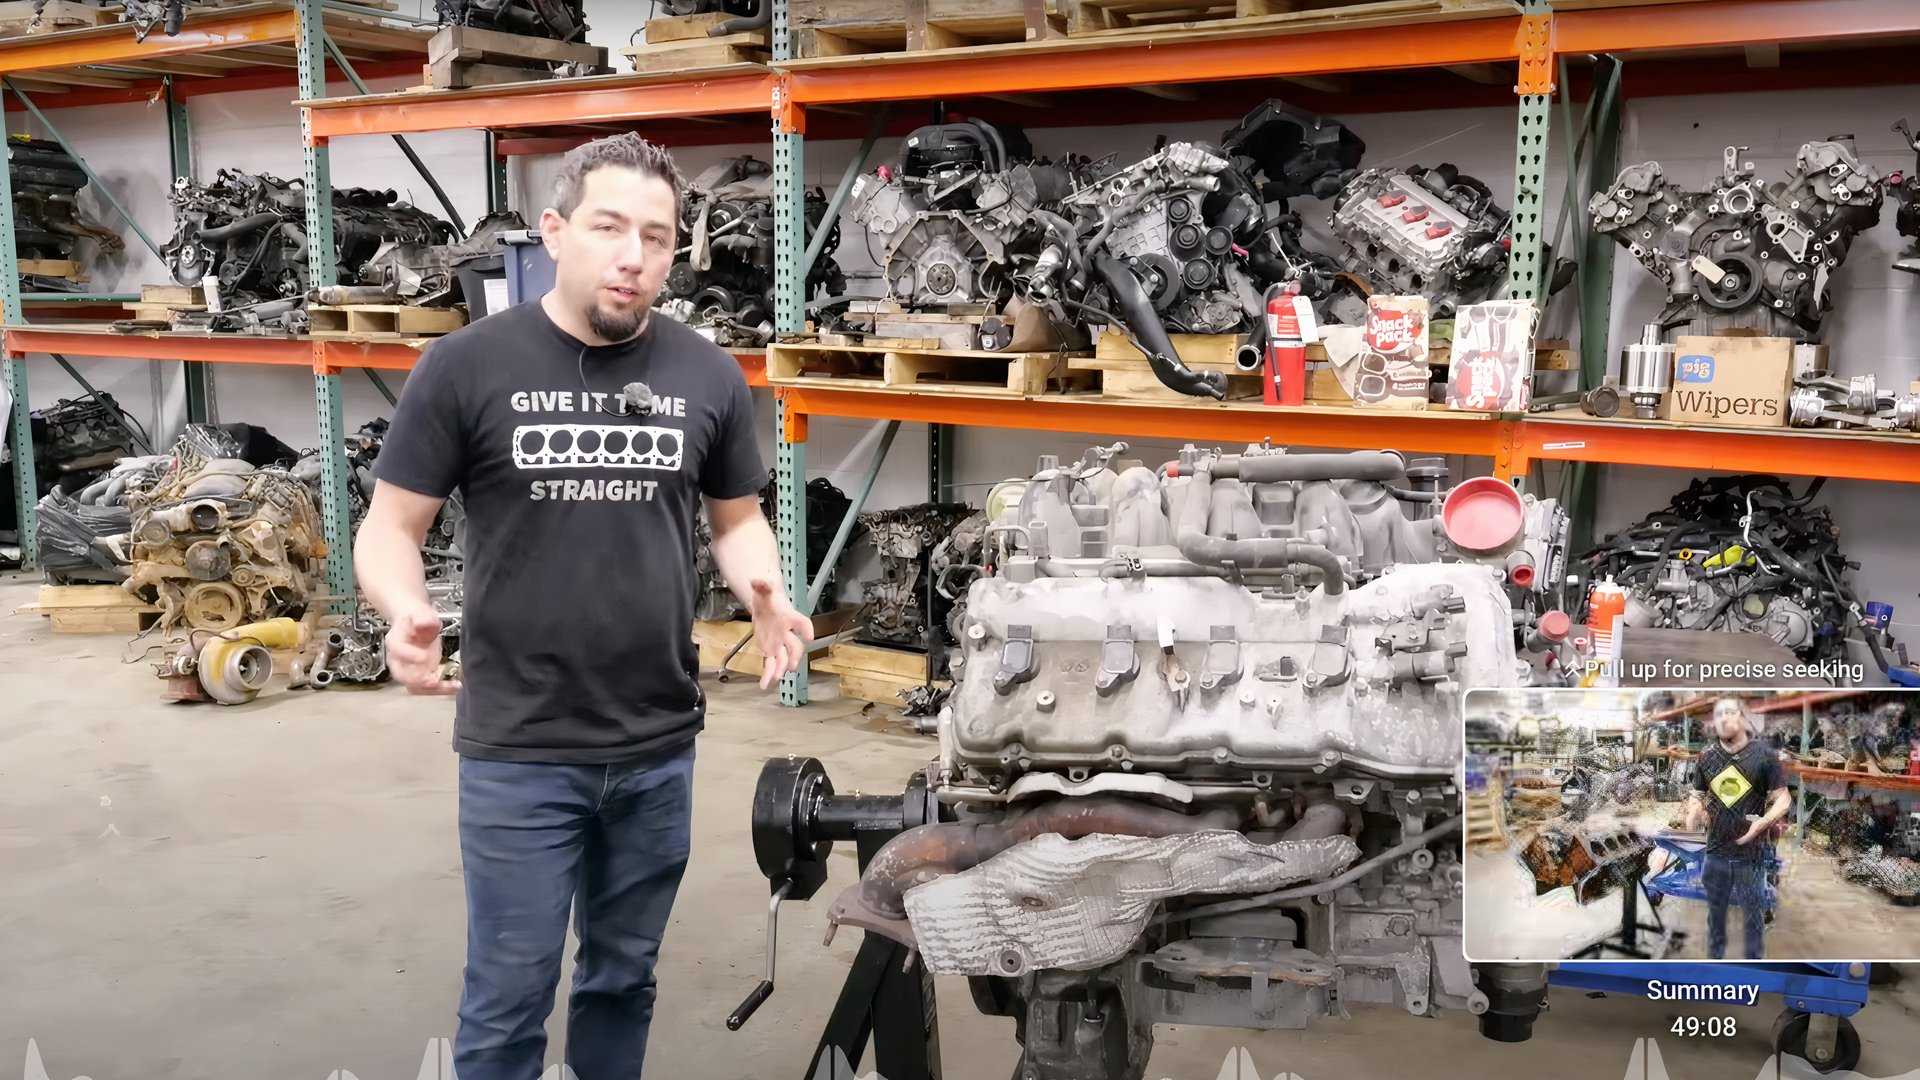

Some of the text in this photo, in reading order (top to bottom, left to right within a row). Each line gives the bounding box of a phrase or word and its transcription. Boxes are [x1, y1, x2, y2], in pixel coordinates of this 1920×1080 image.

[510, 391, 686, 417] GIVE IT TME
[1675, 390, 1778, 419] Wipers
[529, 479, 658, 501] STRAIGHT
